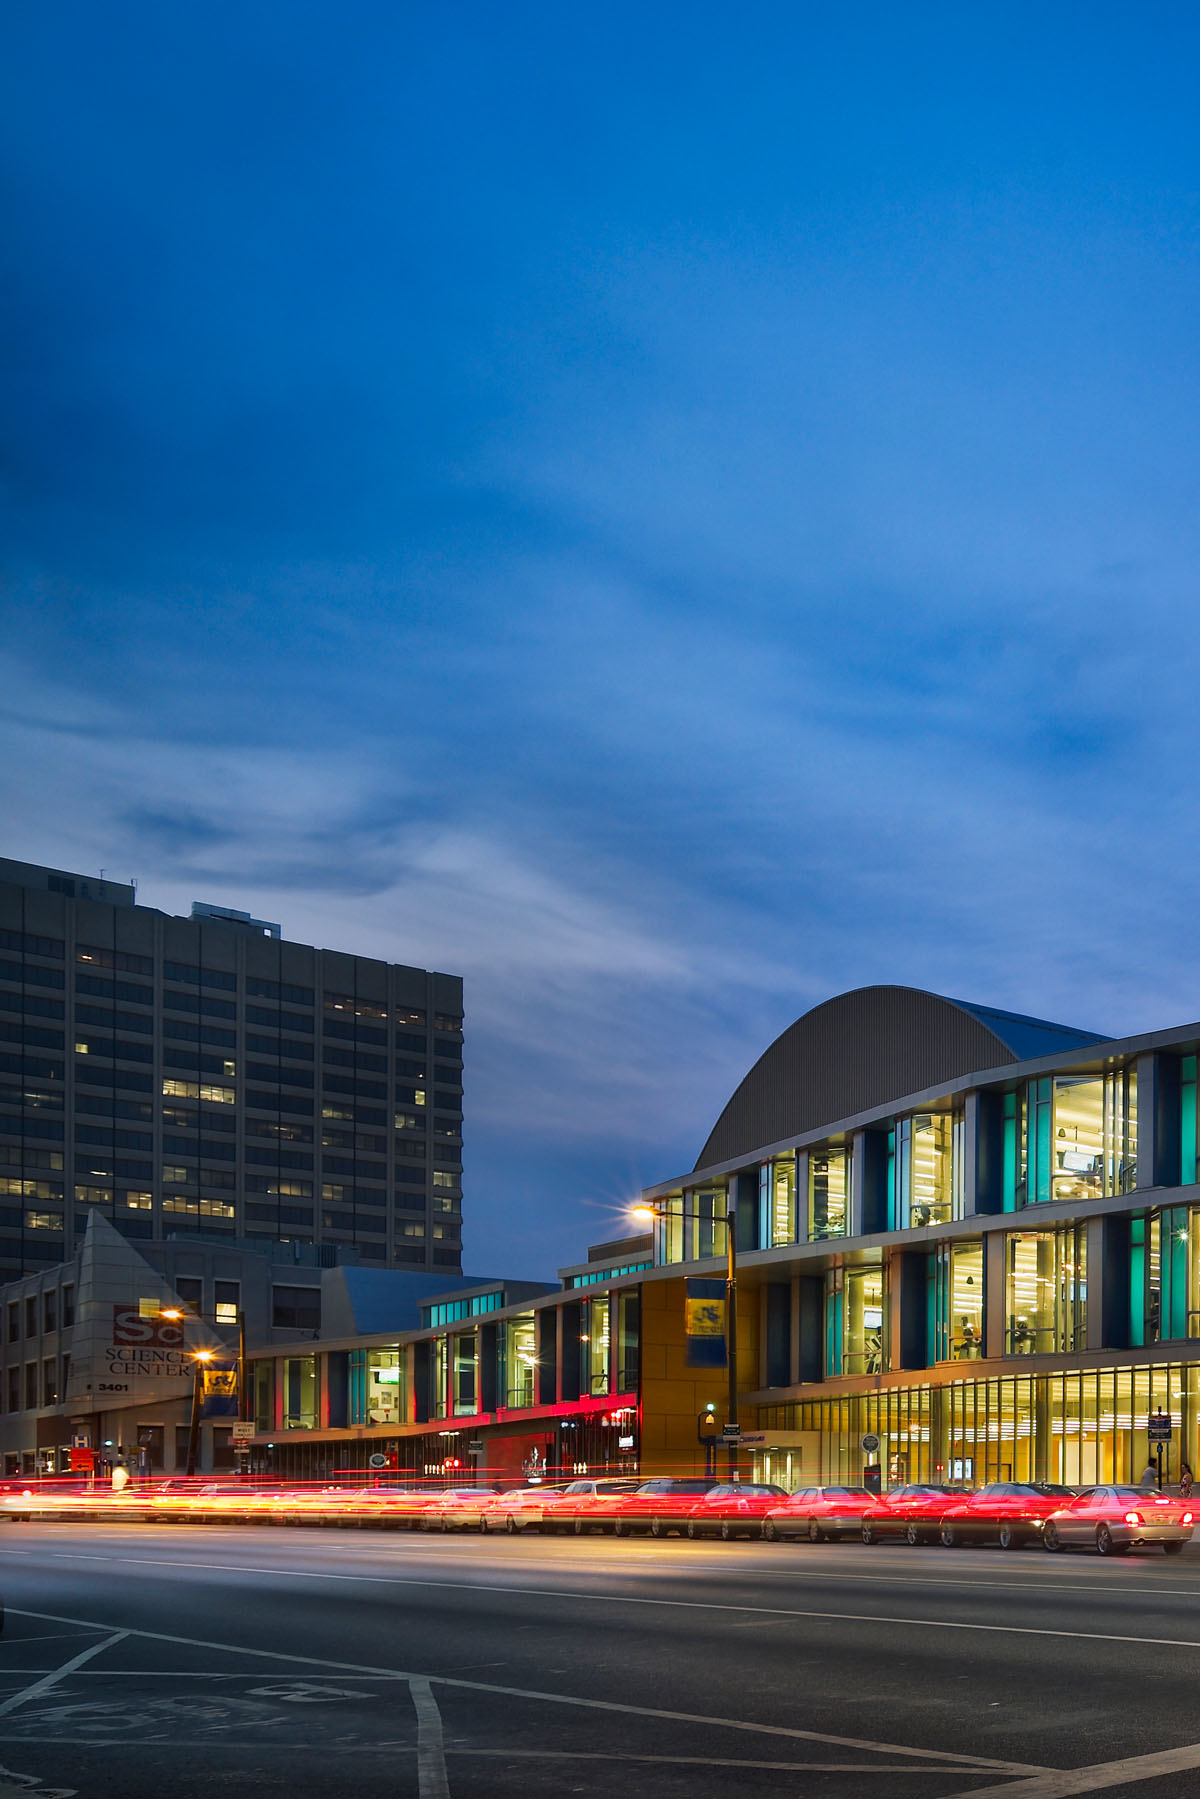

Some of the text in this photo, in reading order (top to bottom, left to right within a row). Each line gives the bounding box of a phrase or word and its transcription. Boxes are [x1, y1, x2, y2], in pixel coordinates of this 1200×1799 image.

[105, 1347, 191, 1363] SCIENCE
[109, 1361, 190, 1377] CENTER
[98, 1383, 129, 1392] 3401
[74, 1436, 88, 1448] H
